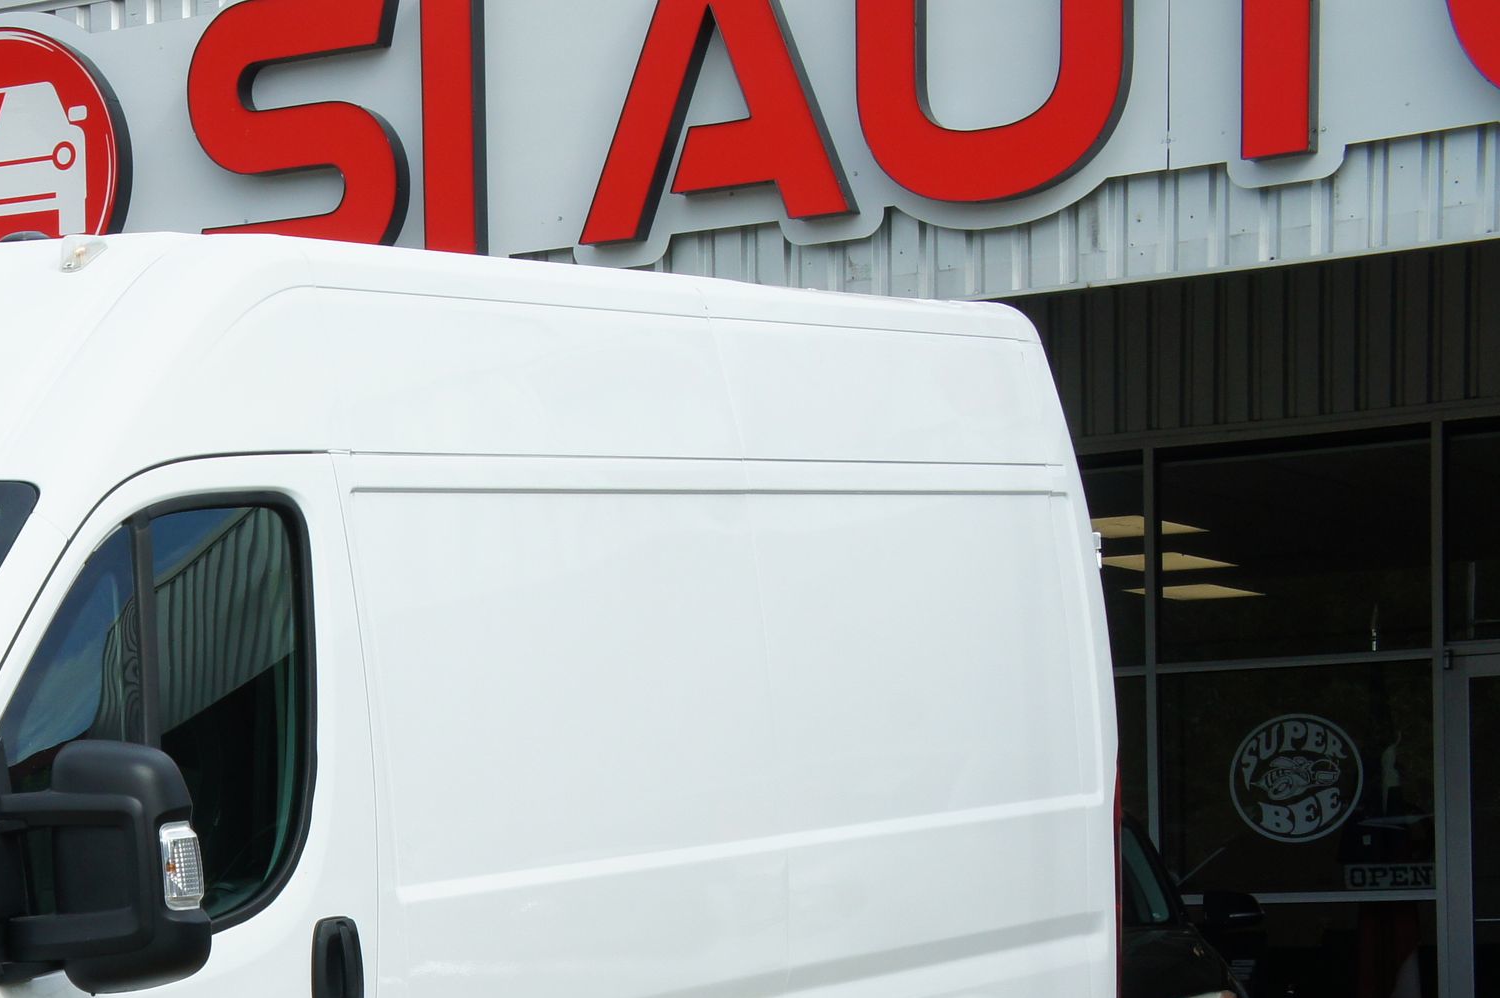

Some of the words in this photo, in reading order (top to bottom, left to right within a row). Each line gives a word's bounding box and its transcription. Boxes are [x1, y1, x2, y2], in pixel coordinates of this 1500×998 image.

[187, 0, 484, 252] SI
[580, 0, 1500, 243] AU
[1241, 721, 1348, 791] SUPER
[1258, 787, 1340, 834] BEE
[1350, 866, 1432, 887] OPEN
